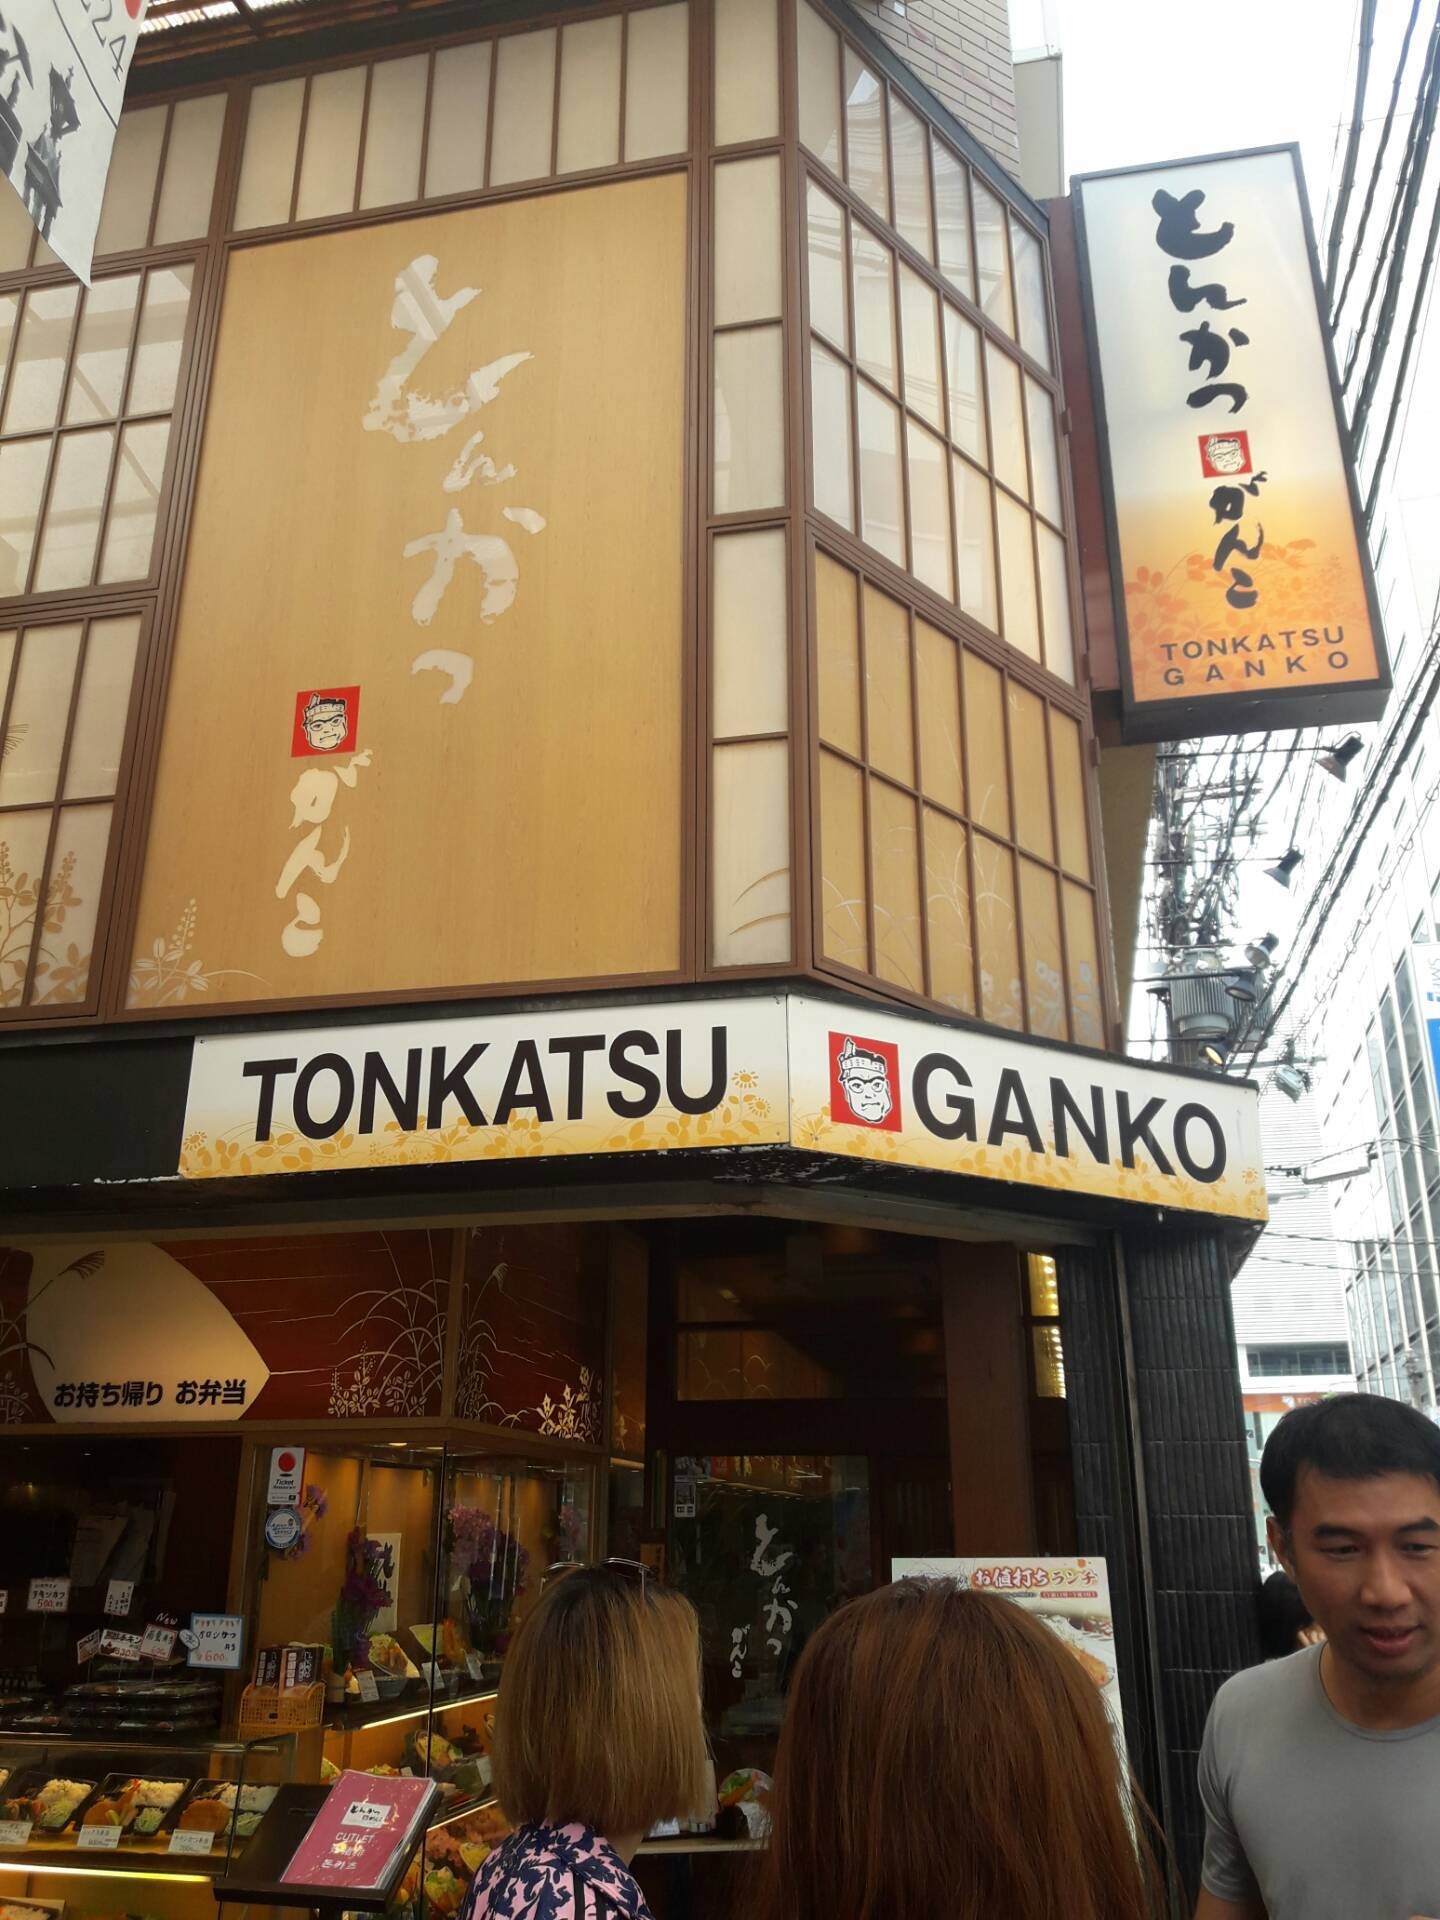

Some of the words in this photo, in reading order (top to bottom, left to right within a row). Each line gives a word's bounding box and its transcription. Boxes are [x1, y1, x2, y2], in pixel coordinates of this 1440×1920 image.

[1152, 188, 1250, 414] とんかつ
[362, 253, 546, 705] とんかつ
[1209, 471, 1267, 609] がんこ
[1160, 625, 1345, 662] TONKATSU
[1164, 651, 1350, 687] GANKO
[276, 749, 374, 957] がんこ
[242, 1026, 728, 1141] TONKATSU
[912, 1053, 1227, 1184] GANKO
[54, 1381, 163, 1408] お持ち帰り
[176, 1379, 245, 1405] お弁当
[750, 1513, 799, 1655] とんかつ
[973, 1567, 1097, 1588] お値打ちランチ
[730, 1624, 751, 1678] がんこ
[335, 1832, 375, 1844] CUTLET
